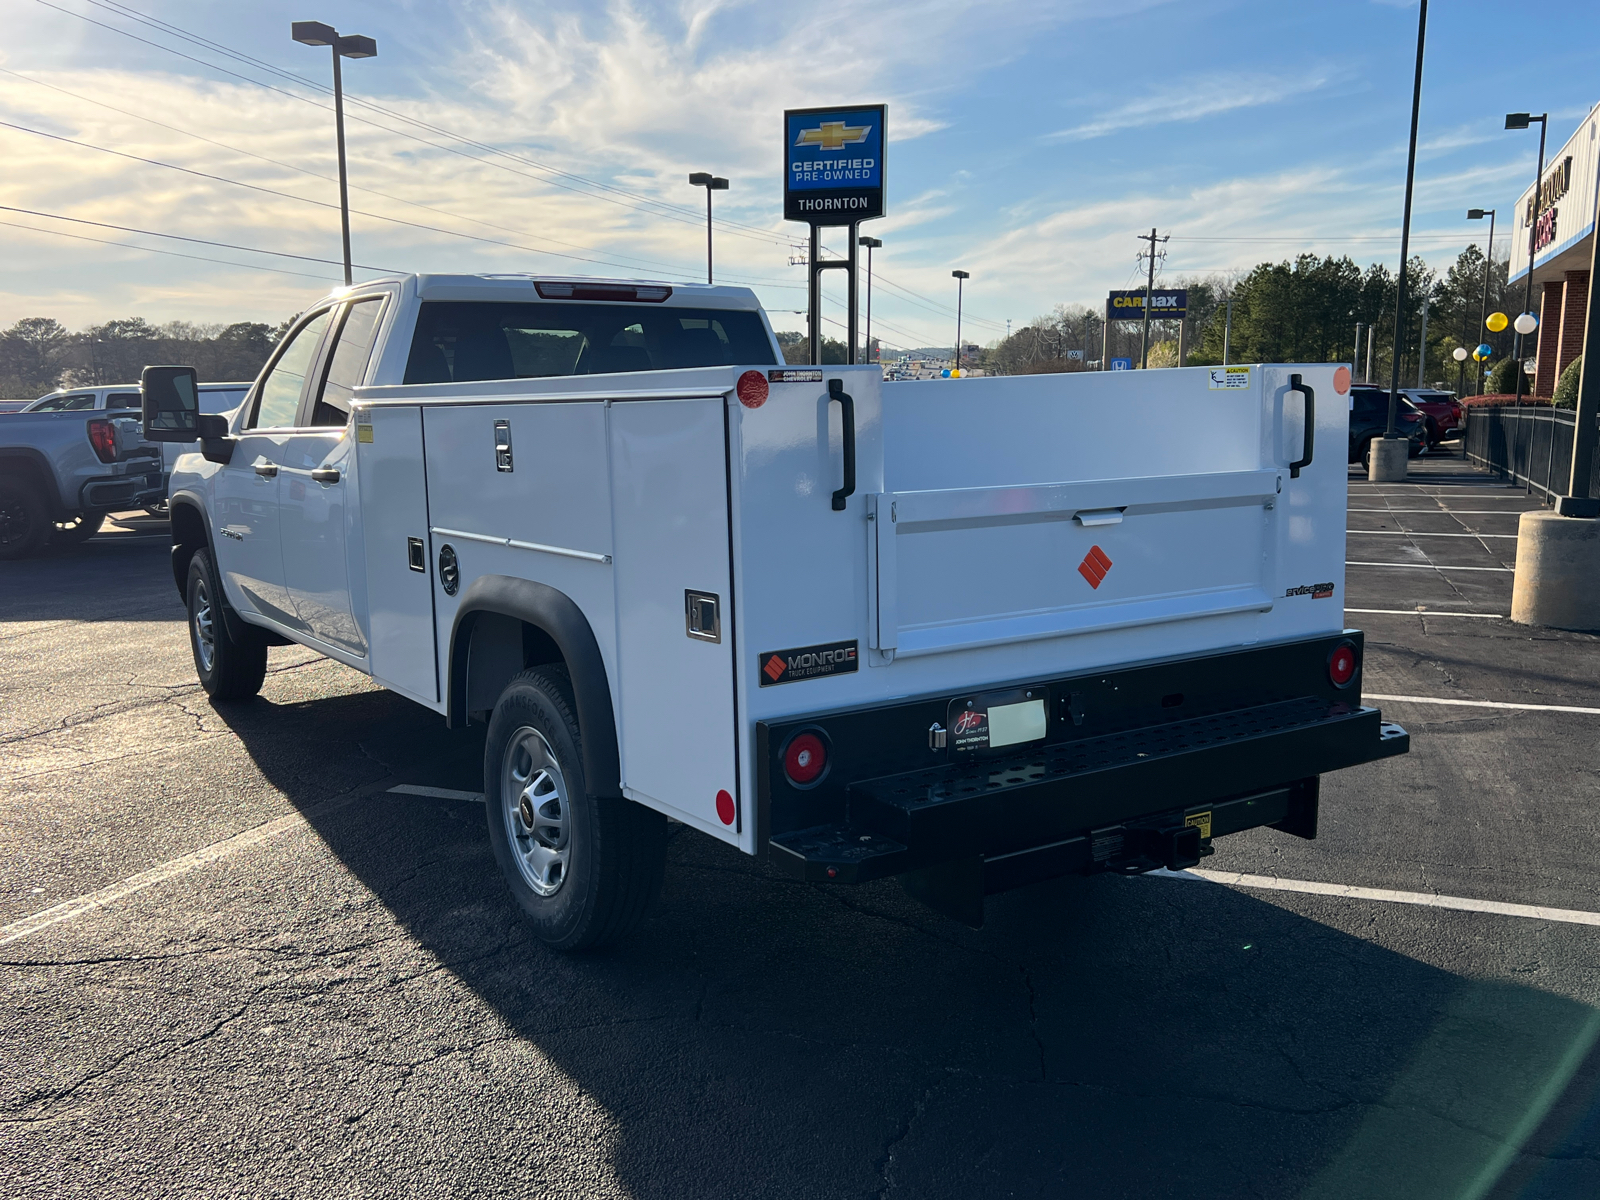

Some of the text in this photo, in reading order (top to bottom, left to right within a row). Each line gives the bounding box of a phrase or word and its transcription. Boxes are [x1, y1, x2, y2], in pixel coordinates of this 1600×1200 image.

[792, 159, 874, 172] CERTIFIED
[796, 170, 870, 181] PRE-OWNED
[798, 197, 868, 210] THORNTON
[788, 647, 856, 670] MONROE
[788, 664, 835, 677] TRUCK EQUIPMENT
[967, 735, 989, 743] THORNTON
[1187, 816, 1209, 827] CAUTION
